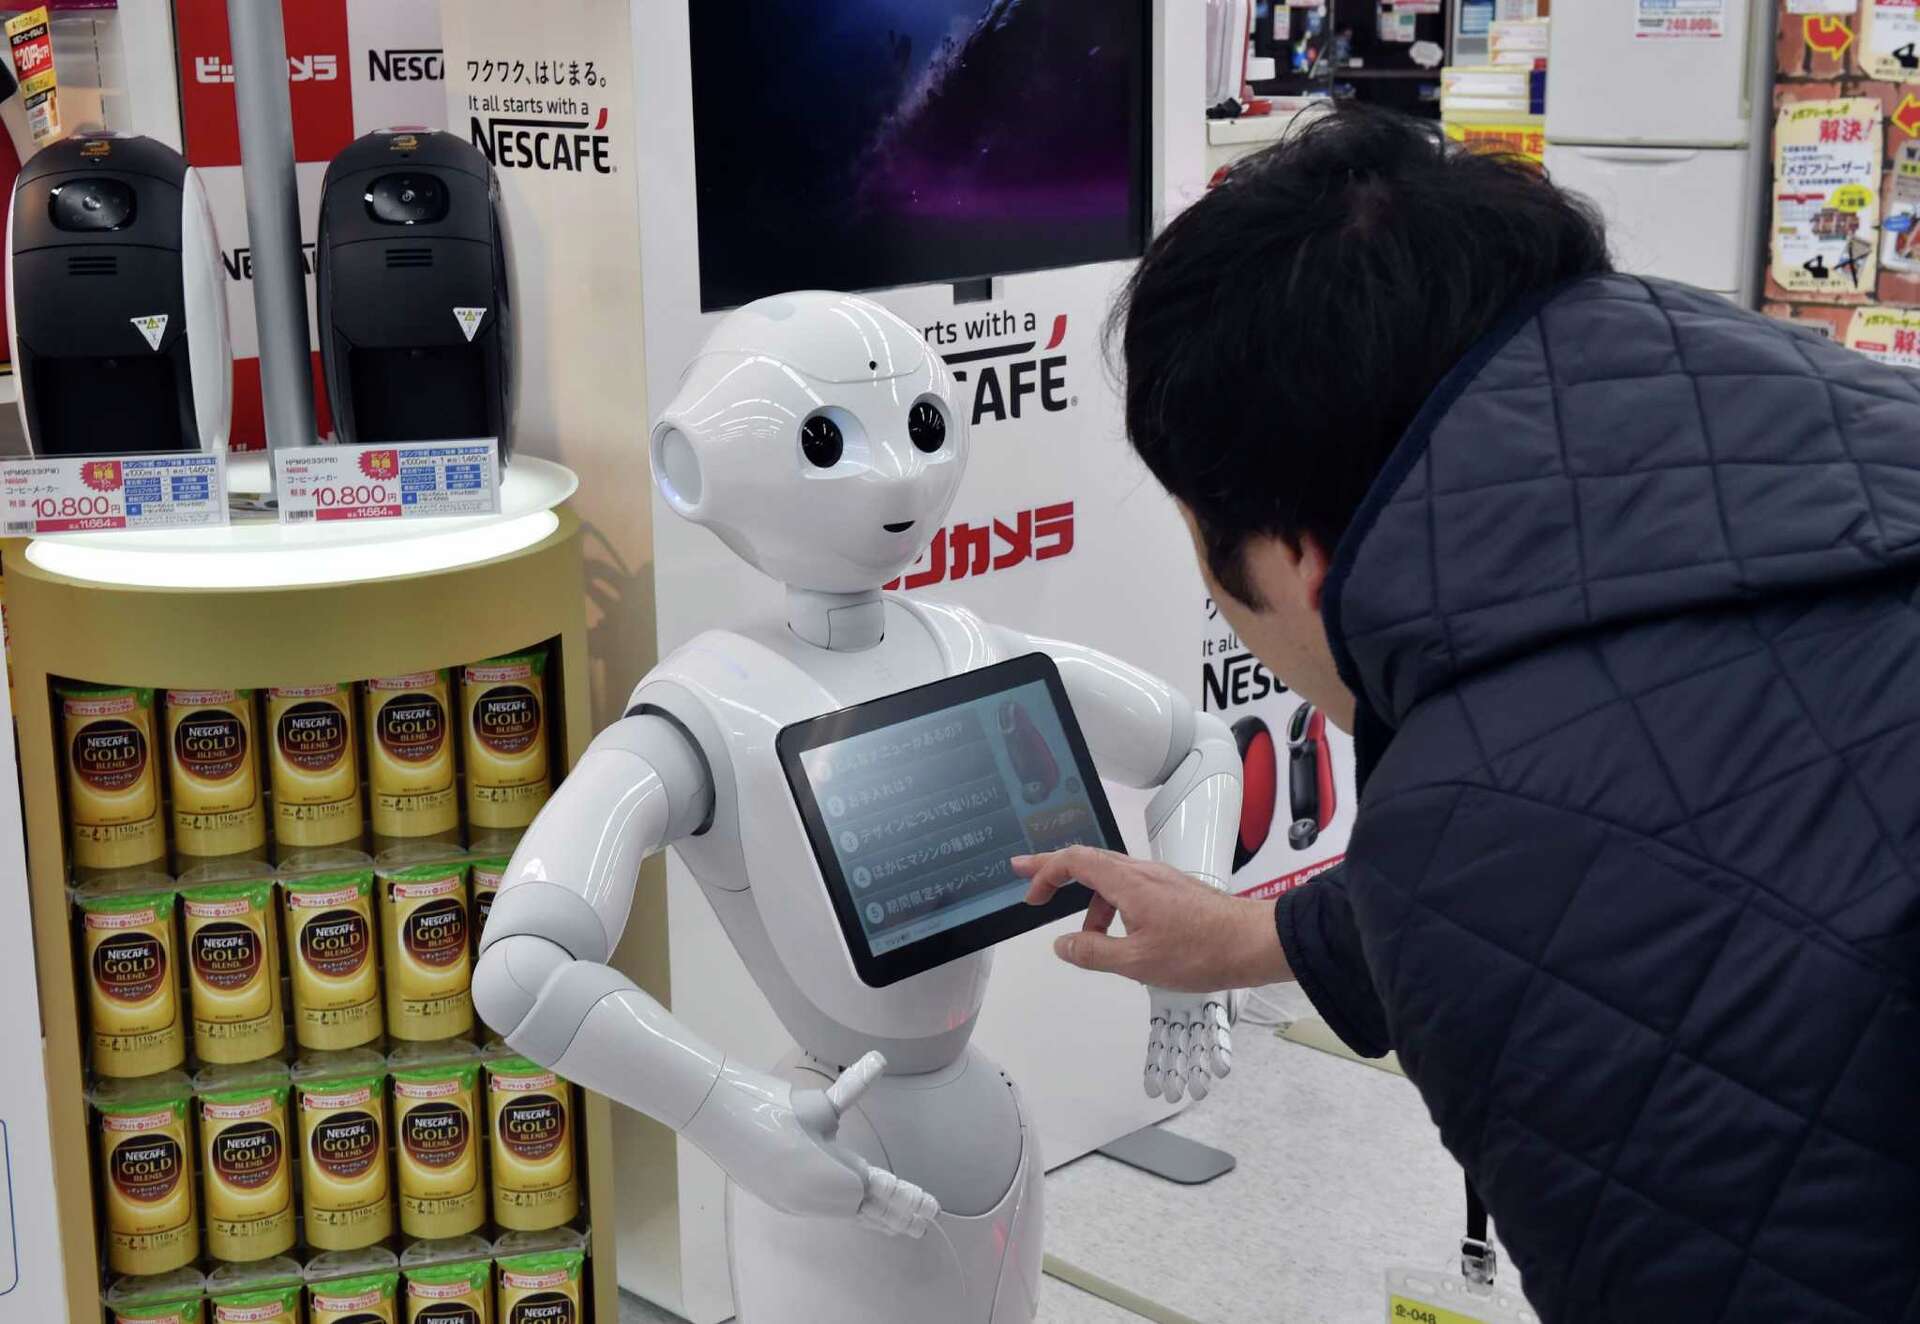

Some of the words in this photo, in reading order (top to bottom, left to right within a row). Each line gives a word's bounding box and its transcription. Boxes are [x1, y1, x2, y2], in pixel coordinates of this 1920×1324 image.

[467, 60, 607, 88] ワクワク、はじまる。
[469, 95, 479, 111] It
[482, 96, 499, 112] all
[503, 97, 543, 114] starts
[546, 98, 577, 115] with
[581, 102, 589, 115] a
[917, 317, 957, 345] rts
[965, 310, 1016, 340] with
[1024, 312, 1036, 331] a
[1202, 640, 1213, 656] It
[485, 711, 531, 726] GOLD
[388, 719, 436, 734] GOLD
[495, 724, 522, 733] BLEND
[288, 728, 337, 742] GOLD
[400, 733, 427, 742] BLEND
[185, 736, 236, 751] GOLD
[300, 742, 329, 750] BLEND
[84, 746, 135, 761] GOLD
[197, 751, 226, 759] BLEND
[96, 761, 126, 769] BLEND
[416, 923, 460, 941] GOLD
[312, 932, 360, 950] GOLD
[428, 937, 454, 947] BLEND
[201, 947, 249, 962] GOLD
[323, 947, 352, 957] BLEND
[104, 957, 155, 974] GOLD
[211, 961, 240, 970] BLEND
[116, 972, 147, 981] BLEND
[509, 1118, 556, 1133] GOLD
[411, 1126, 459, 1141] GOLD
[520, 1131, 548, 1140] BLEND
[323, 1134, 371, 1152] GOLD
[422, 1139, 450, 1148] BLEND
[223, 1146, 272, 1162] GOLD
[334, 1149, 363, 1159] BLEND
[122, 1158, 172, 1175] GOLD
[235, 1160, 263, 1170] BLEND
[133, 1173, 163, 1182] BLEND
